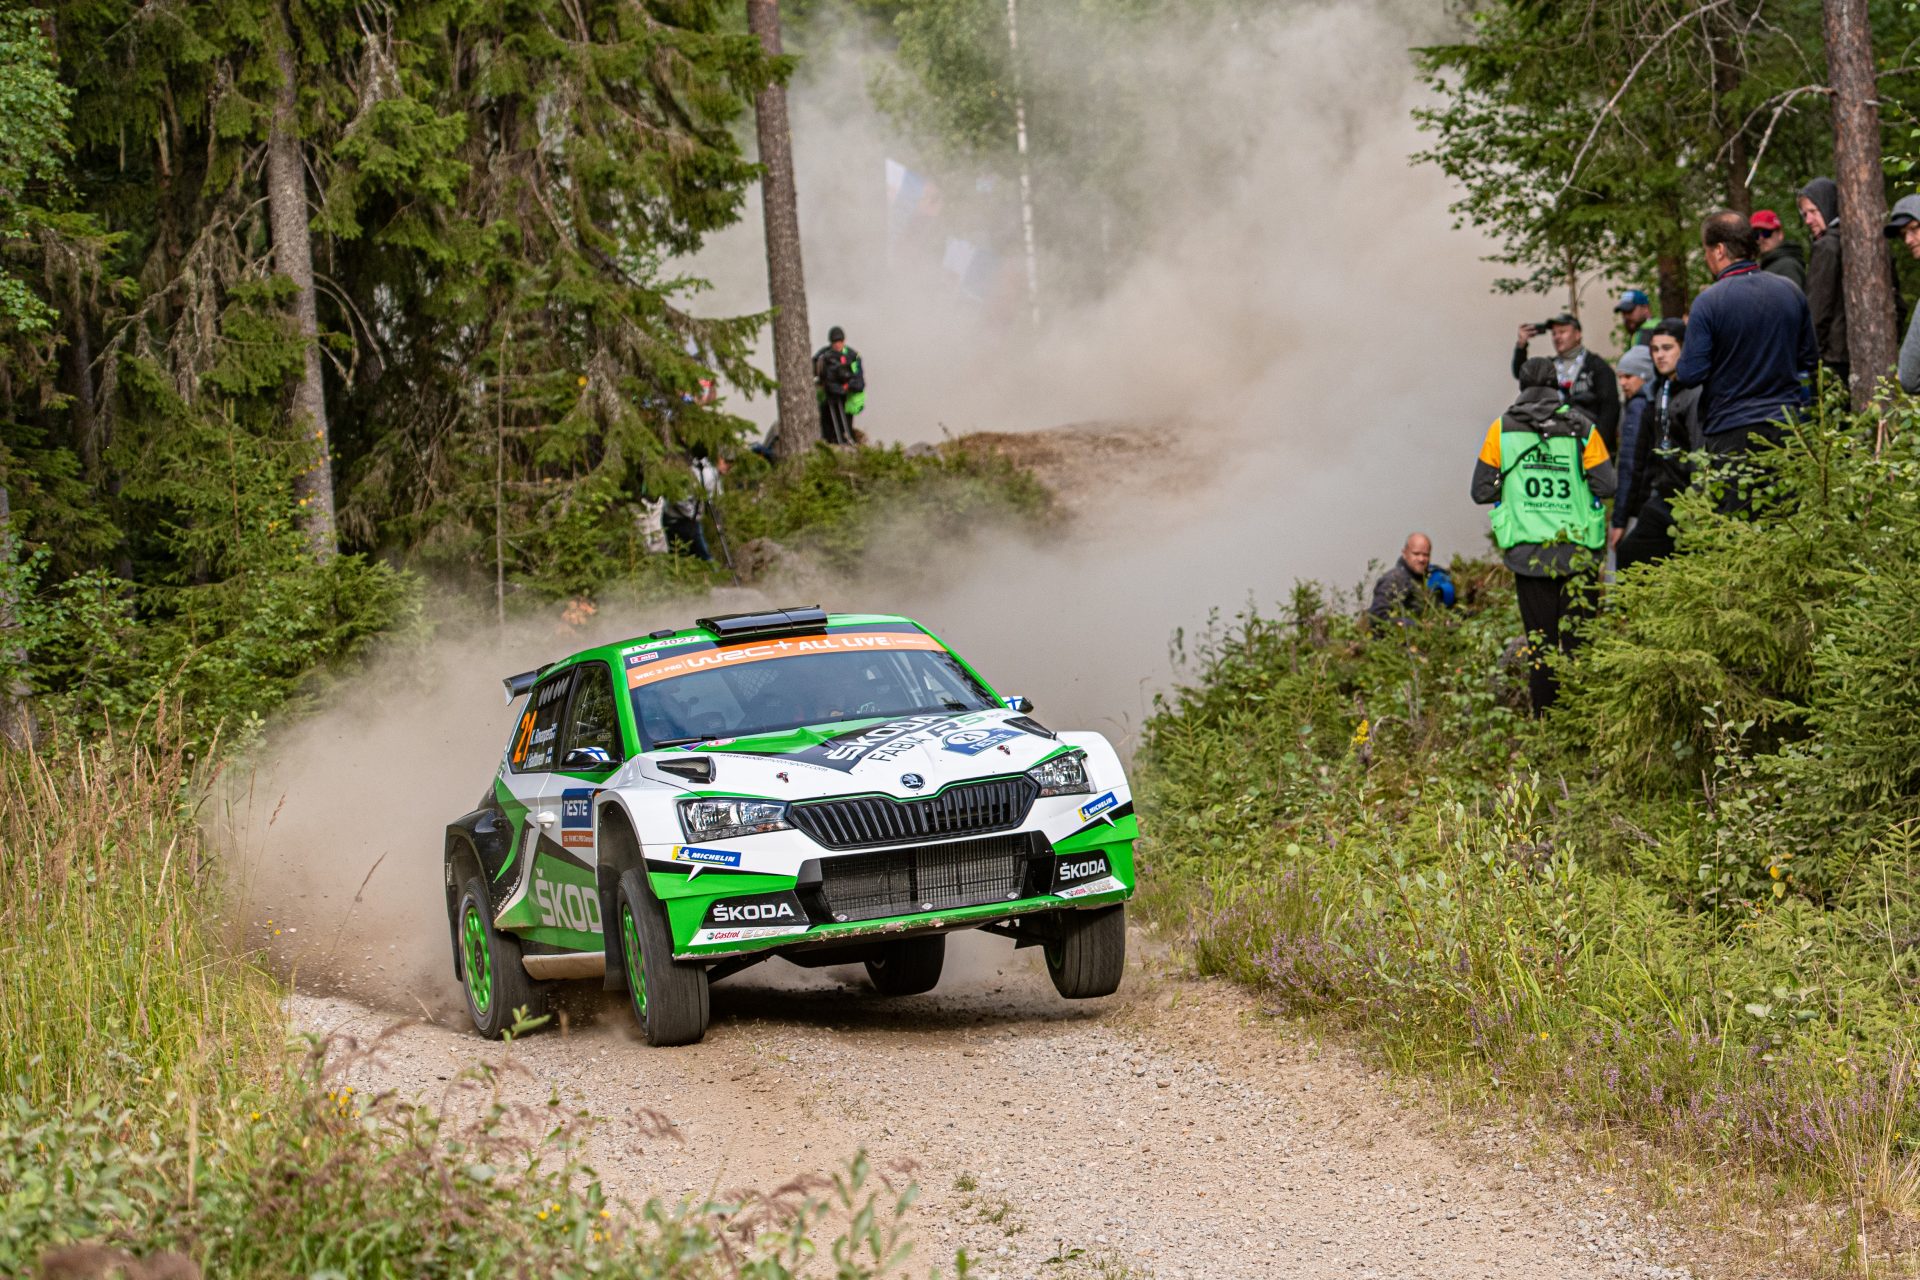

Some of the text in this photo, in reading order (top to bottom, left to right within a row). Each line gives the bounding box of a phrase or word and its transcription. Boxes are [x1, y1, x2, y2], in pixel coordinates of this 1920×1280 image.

[1525, 477, 1571, 499] 033
[799, 636, 838, 652] ALL
[842, 635, 891, 648] LIVE
[513, 710, 537, 763] 21
[868, 736, 934, 762] FABIA
[691, 852, 736, 863] MICHELIN
[1060, 858, 1107, 881] ŠKODA
[535, 868, 603, 934] ŠKOD
[713, 902, 795, 922] ŠKODA
[714, 930, 741, 940] Castrol
